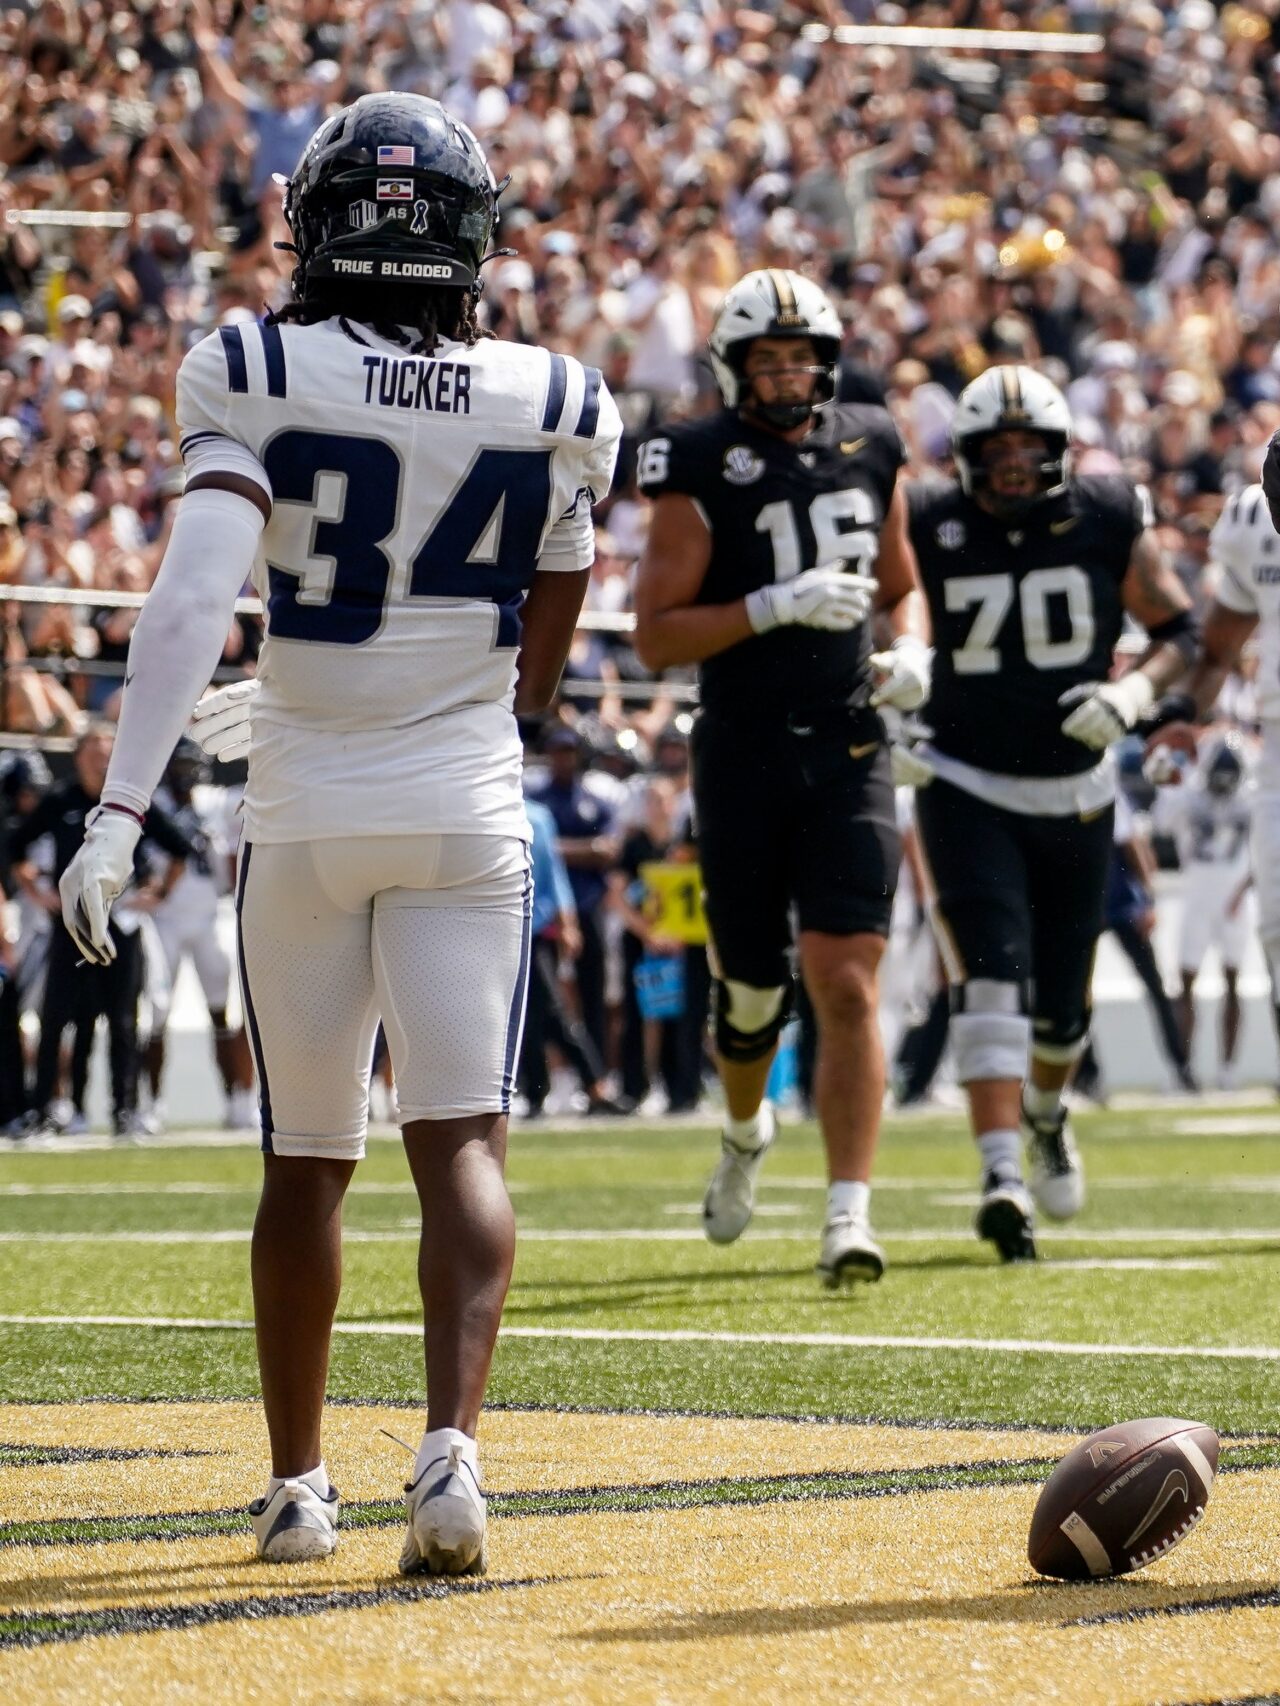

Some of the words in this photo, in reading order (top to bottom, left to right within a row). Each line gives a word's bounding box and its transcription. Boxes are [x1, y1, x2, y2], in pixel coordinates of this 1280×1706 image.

[387, 207, 407, 219] AS
[332, 258, 374, 274] TRUE
[381, 262, 453, 278] BLOODED
[363, 355, 471, 414] TUCKER
[258, 424, 557, 652] 34
[755, 488, 879, 584] 16
[944, 565, 1094, 675] 70
